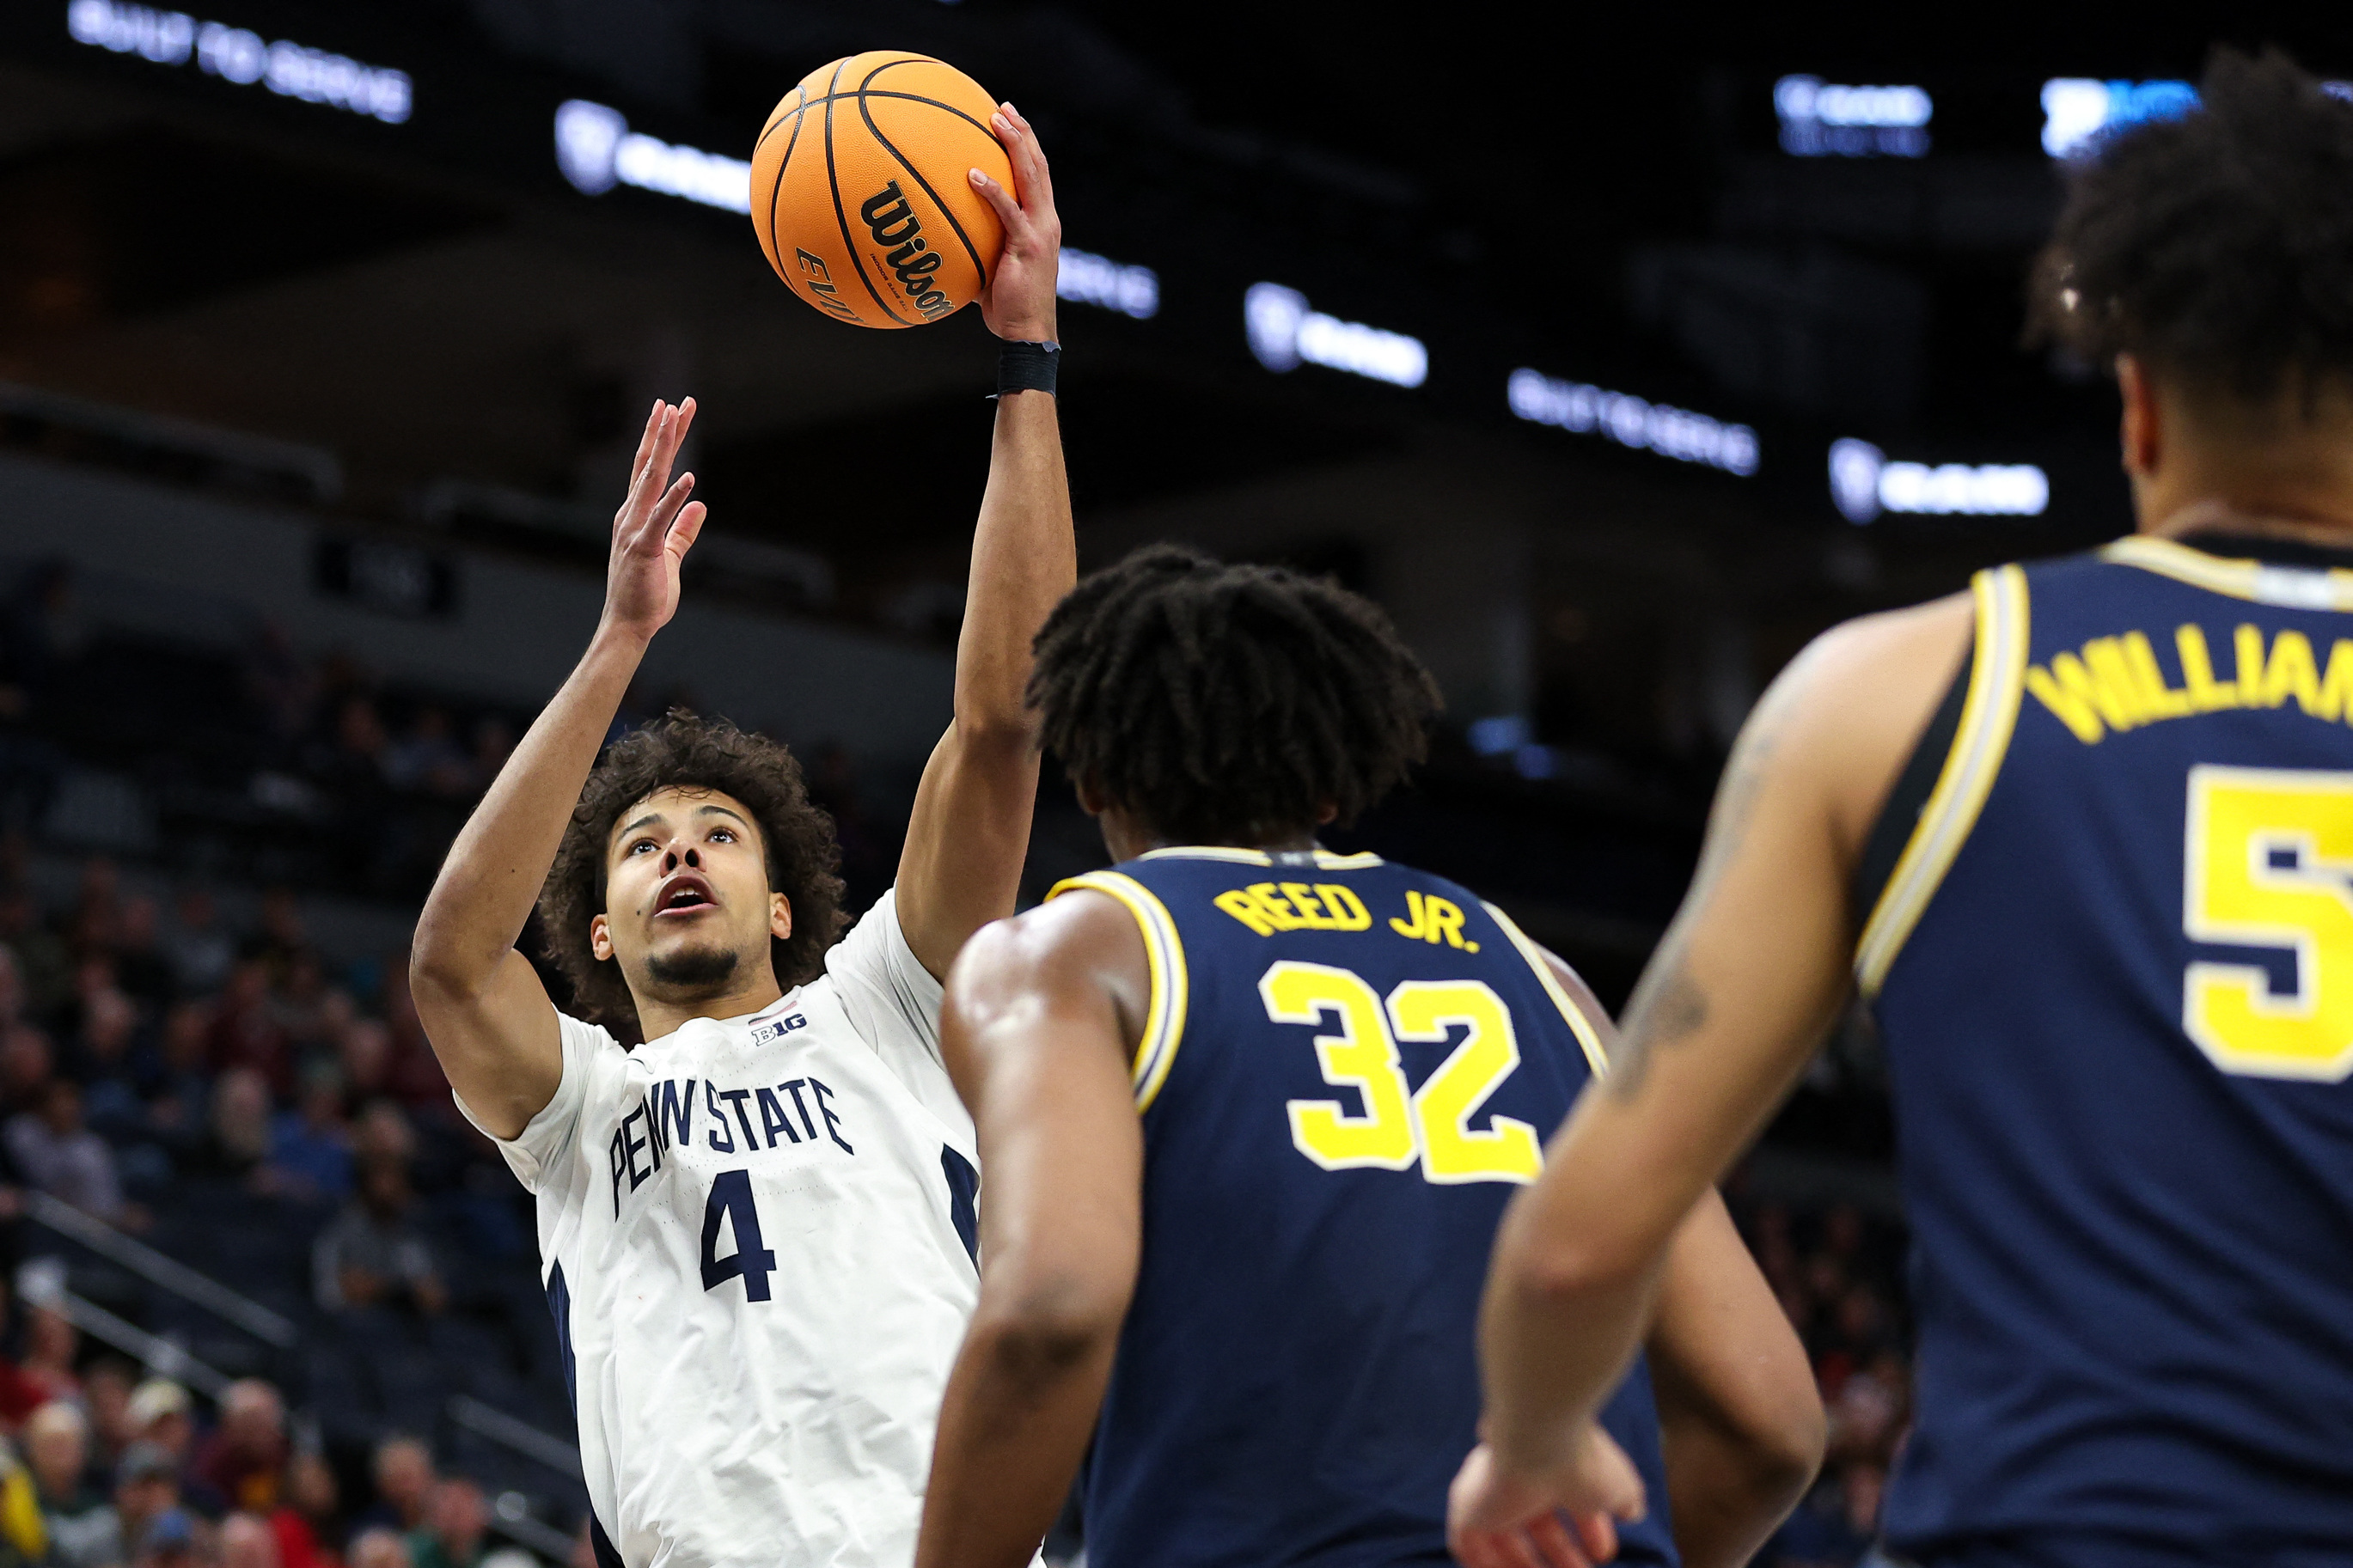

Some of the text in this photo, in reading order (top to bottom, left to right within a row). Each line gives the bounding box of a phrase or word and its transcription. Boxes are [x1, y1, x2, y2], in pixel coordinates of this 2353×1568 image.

[860, 179, 956, 322] Wilson
[1213, 882, 1481, 954] REED JR.
[2183, 763, 2353, 1084] 5
[1257, 960, 1545, 1185] 32
[609, 1077, 855, 1223] PENN STATE
[700, 1168, 778, 1303] 4
